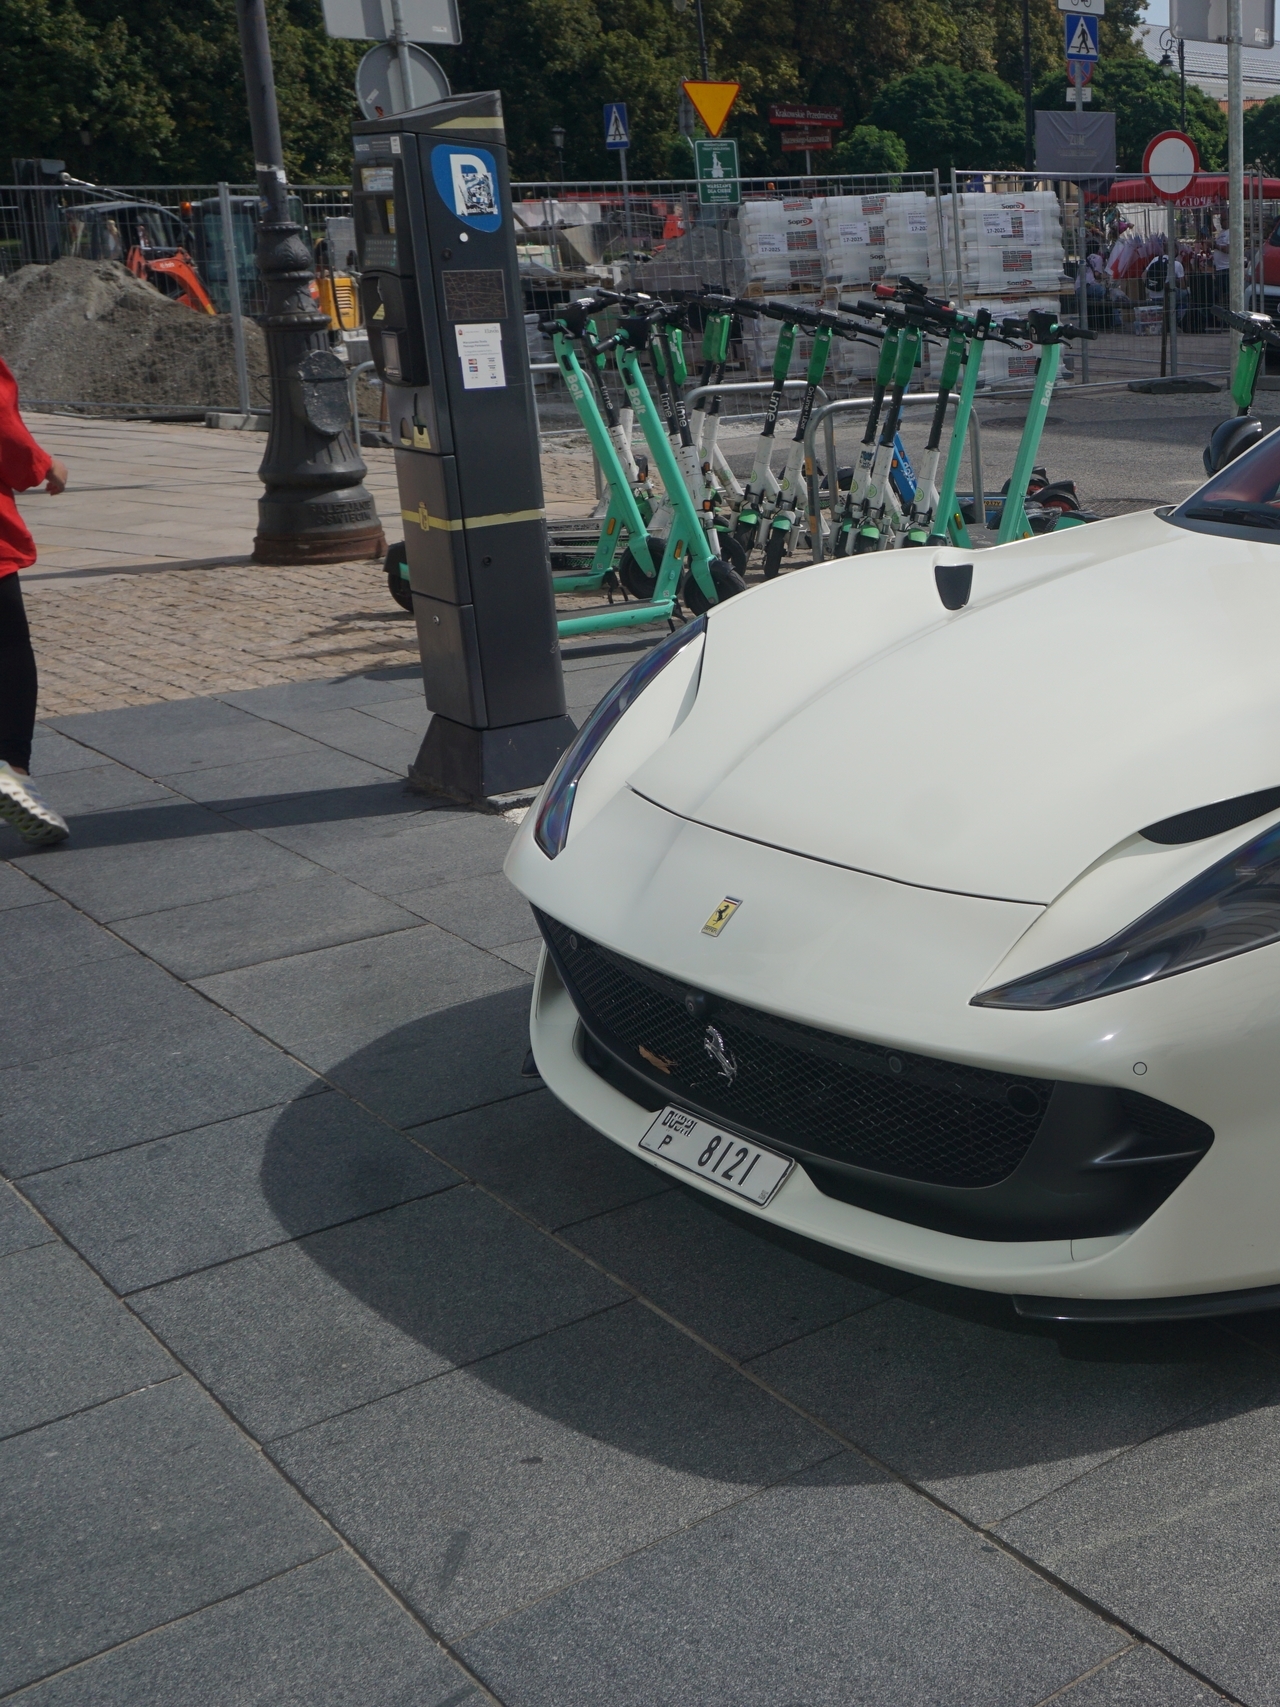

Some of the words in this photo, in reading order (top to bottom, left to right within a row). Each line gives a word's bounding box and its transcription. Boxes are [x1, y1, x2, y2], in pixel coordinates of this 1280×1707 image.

[774, 108, 805, 119] Krakowskie
[806, 110, 838, 120] Przedmieście
[566, 374, 584, 401] Bolt
[628, 387, 646, 414] Bolt
[1041, 380, 1054, 407] Bolt
[660, 392, 673, 418] Lime
[675, 400, 687, 427] Lime
[766, 390, 781, 422] Lime
[657, 1134, 673, 1150] P
[697, 1135, 761, 1186] 8121
